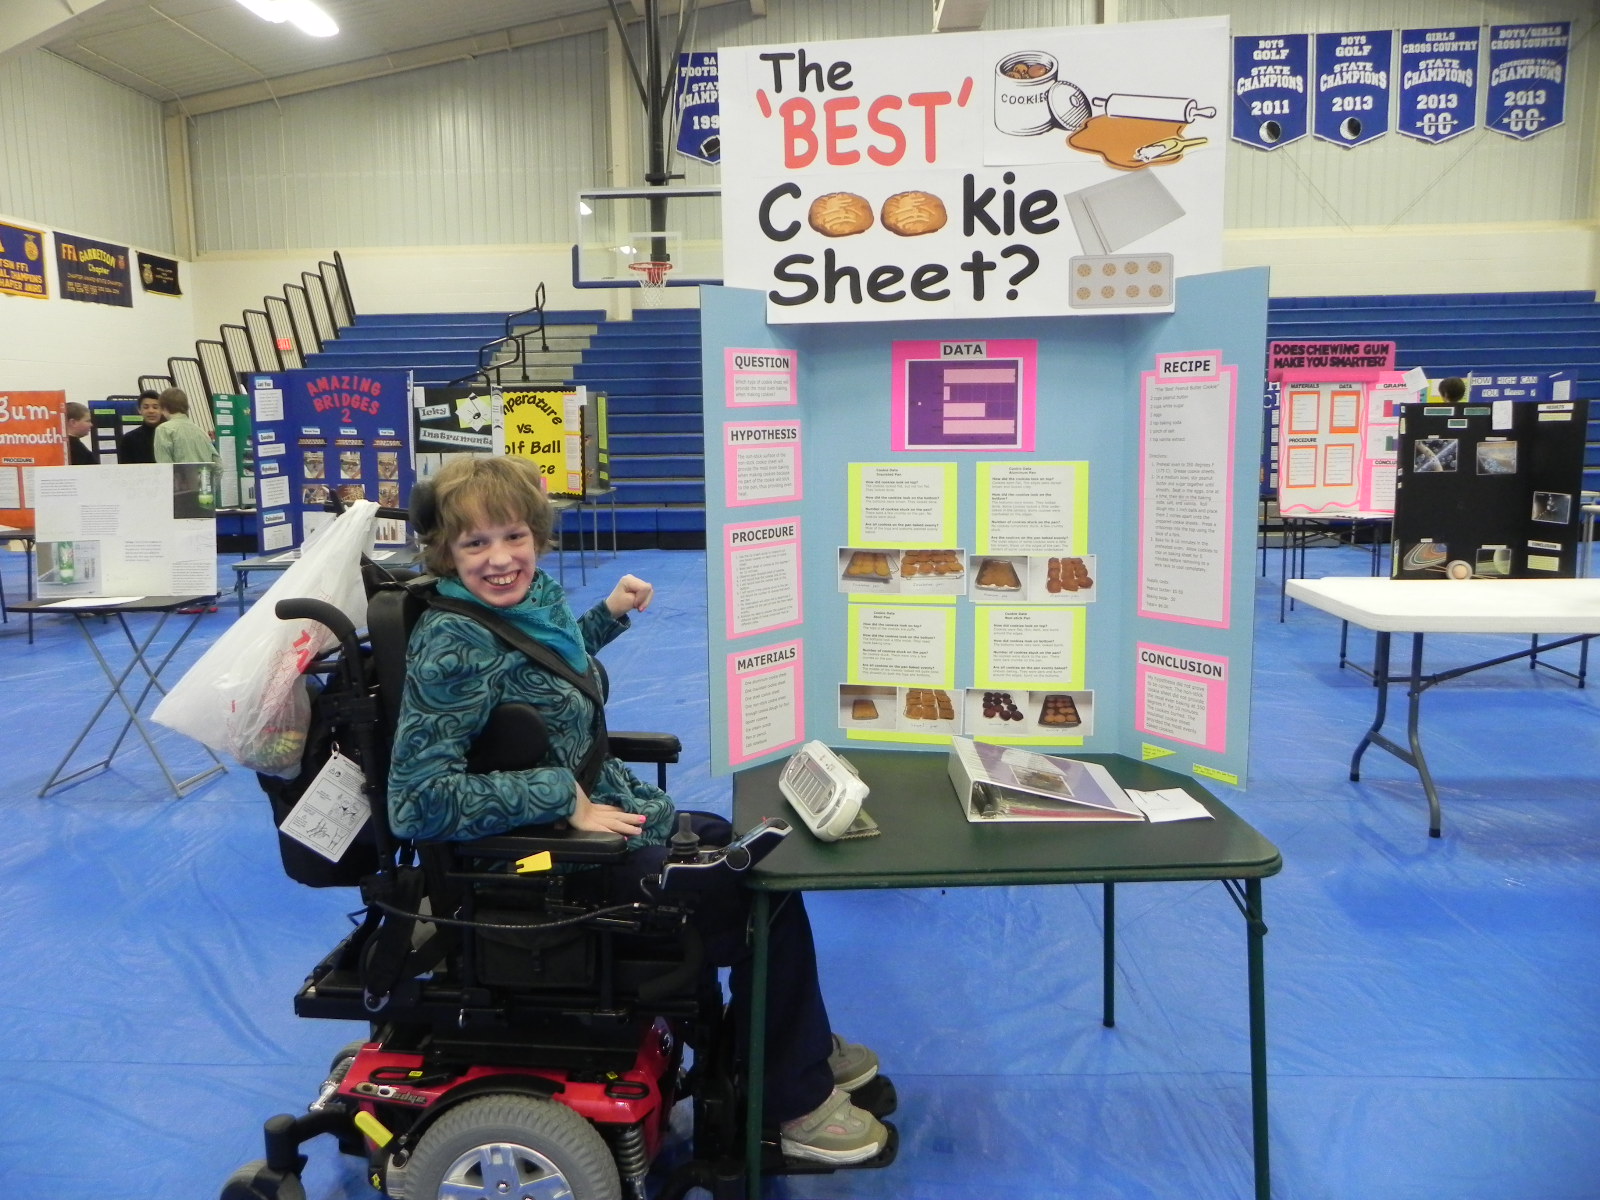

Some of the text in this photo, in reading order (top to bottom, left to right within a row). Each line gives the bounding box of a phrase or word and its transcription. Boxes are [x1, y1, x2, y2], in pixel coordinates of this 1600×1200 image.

[1340, 36, 1366, 46] BOYS
[1426, 32, 1456, 42] GIRLS
[1258, 40, 1284, 49] BOYS
[1402, 41, 1478, 54] CROSS COUNTRY
[1491, 39, 1520, 50] CROSS
[1253, 49, 1290, 60] GOLF
[1336, 46, 1372, 57] GOLF
[1333, 62, 1373, 72] STATE
[1419, 58, 1460, 69] STATE
[681, 67, 718, 77] FOOTB
[759, 48, 854, 94] The
[1251, 66, 1290, 76] STATE
[1491, 64, 1562, 86] CHAMPIONS
[1236, 74, 1303, 96] CHAMPIONS
[1320, 70, 1387, 92] CHAMPIONS
[1404, 68, 1473, 90] CHAMPIONS
[1332, 96, 1373, 112] 2013
[1417, 94, 1458, 109] 2013
[1504, 90, 1546, 106] 2013
[1251, 100, 1290, 115] 2011
[768, 243, 1040, 306] Sheet?
[943, 344, 983, 356] DATA
[1273, 344, 1389, 355] DOES CHEWING GUM
[734, 355, 790, 369] QUESTION
[1164, 360, 1210, 373] RECIPE
[1274, 356, 1386, 368] MAKE YOU SMARTER?
[306, 375, 382, 397] AMAZING
[313, 393, 380, 416] BRIDGES
[341, 408, 353, 423] 2
[421, 407, 447, 417] Icky
[517, 423, 534, 434] vs.
[730, 428, 797, 441] HYPOTHESIS
[530, 440, 560, 454] Ball
[732, 525, 794, 544] PROCEDURE
[737, 647, 796, 670] MATERIALS
[1141, 651, 1222, 677] CONCLUSION
